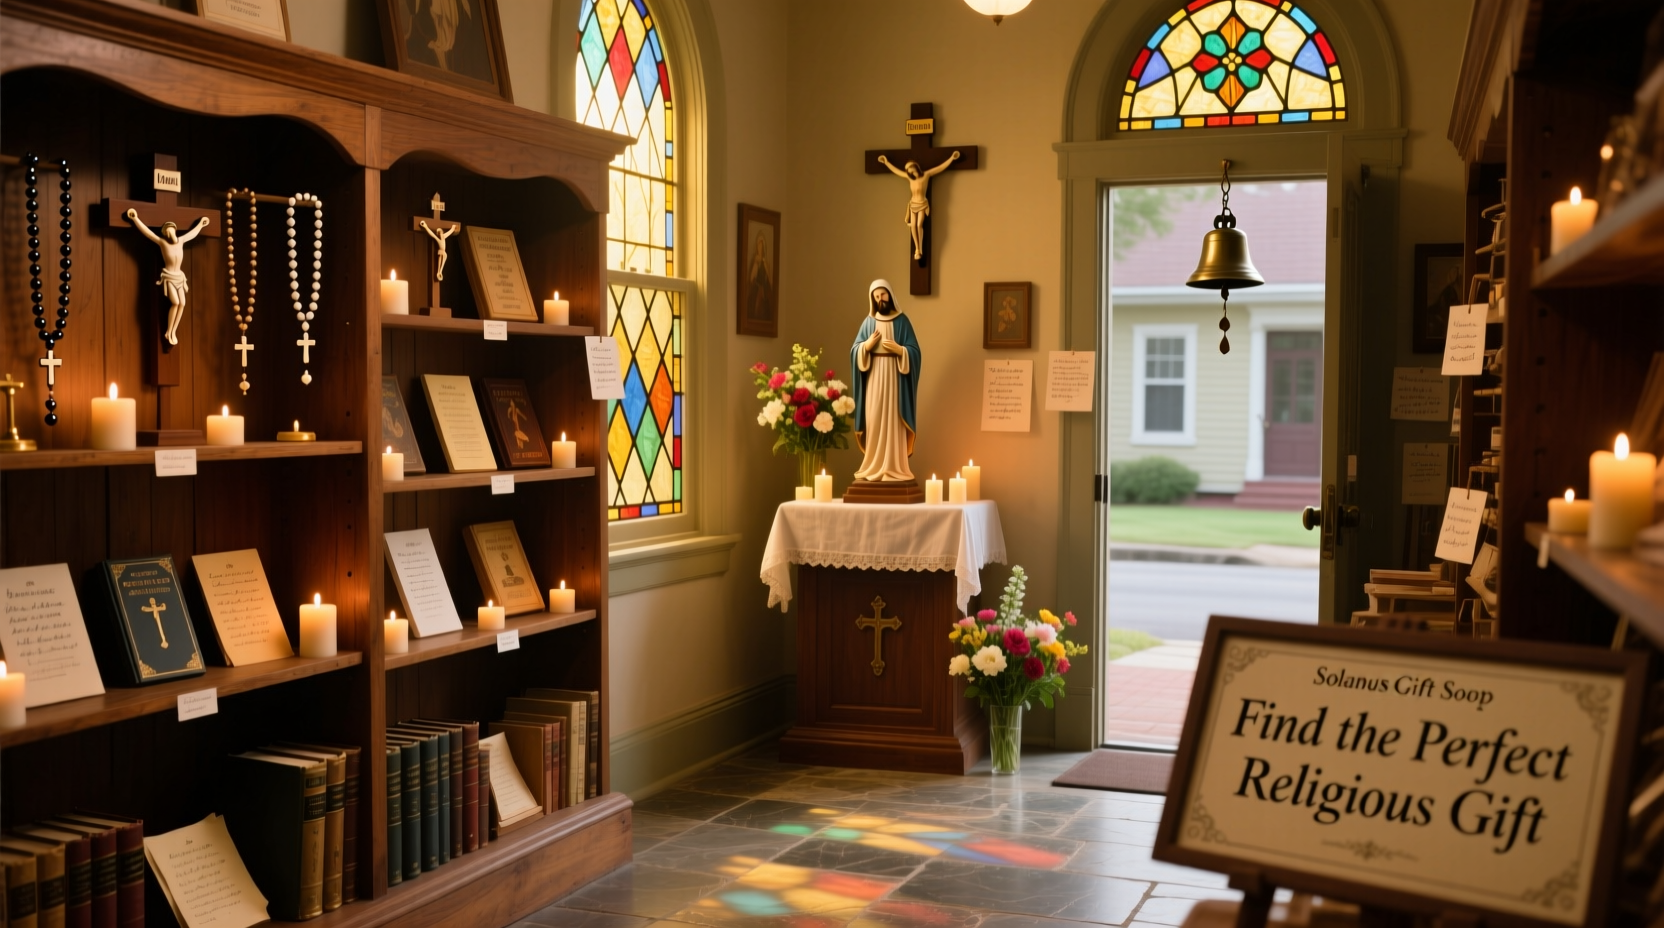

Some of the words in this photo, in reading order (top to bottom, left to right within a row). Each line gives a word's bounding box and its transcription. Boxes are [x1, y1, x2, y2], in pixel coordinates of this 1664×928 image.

[1313, 666, 1389, 693] Solanus
[1394, 675, 1436, 699] Gift
[1230, 698, 1328, 747] Find
[1337, 712, 1401, 758] the
[1410, 719, 1572, 785] Perfect
[1233, 755, 1435, 825] Religious
[1450, 790, 1547, 854] Gift
